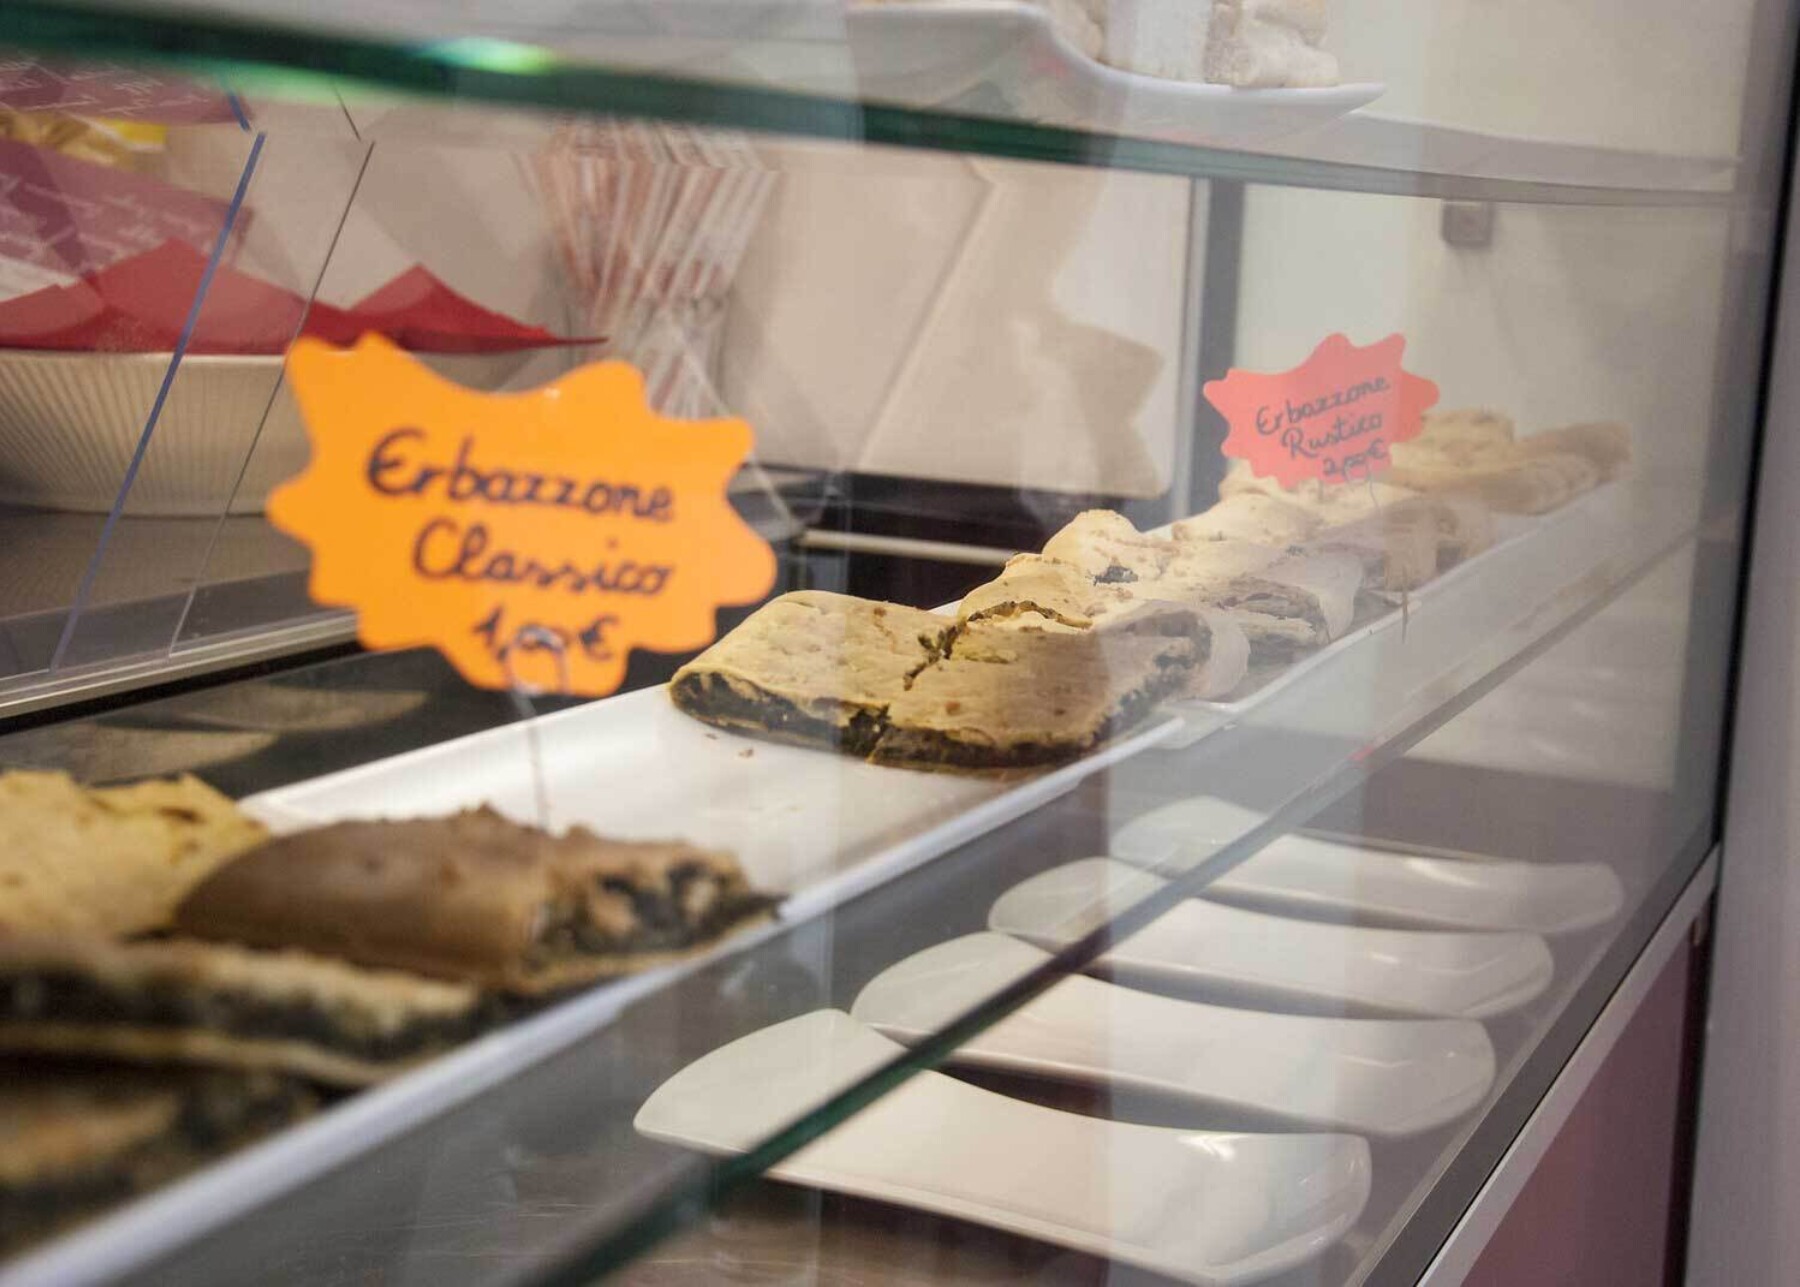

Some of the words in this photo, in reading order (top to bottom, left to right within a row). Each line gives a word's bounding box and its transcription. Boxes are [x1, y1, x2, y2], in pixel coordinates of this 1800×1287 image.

[1257, 377, 1391, 435] Erbazzone
[1281, 413, 1383, 458] Rustico
[367, 428, 672, 521] Erbazzone
[413, 518, 672, 595] Classico
